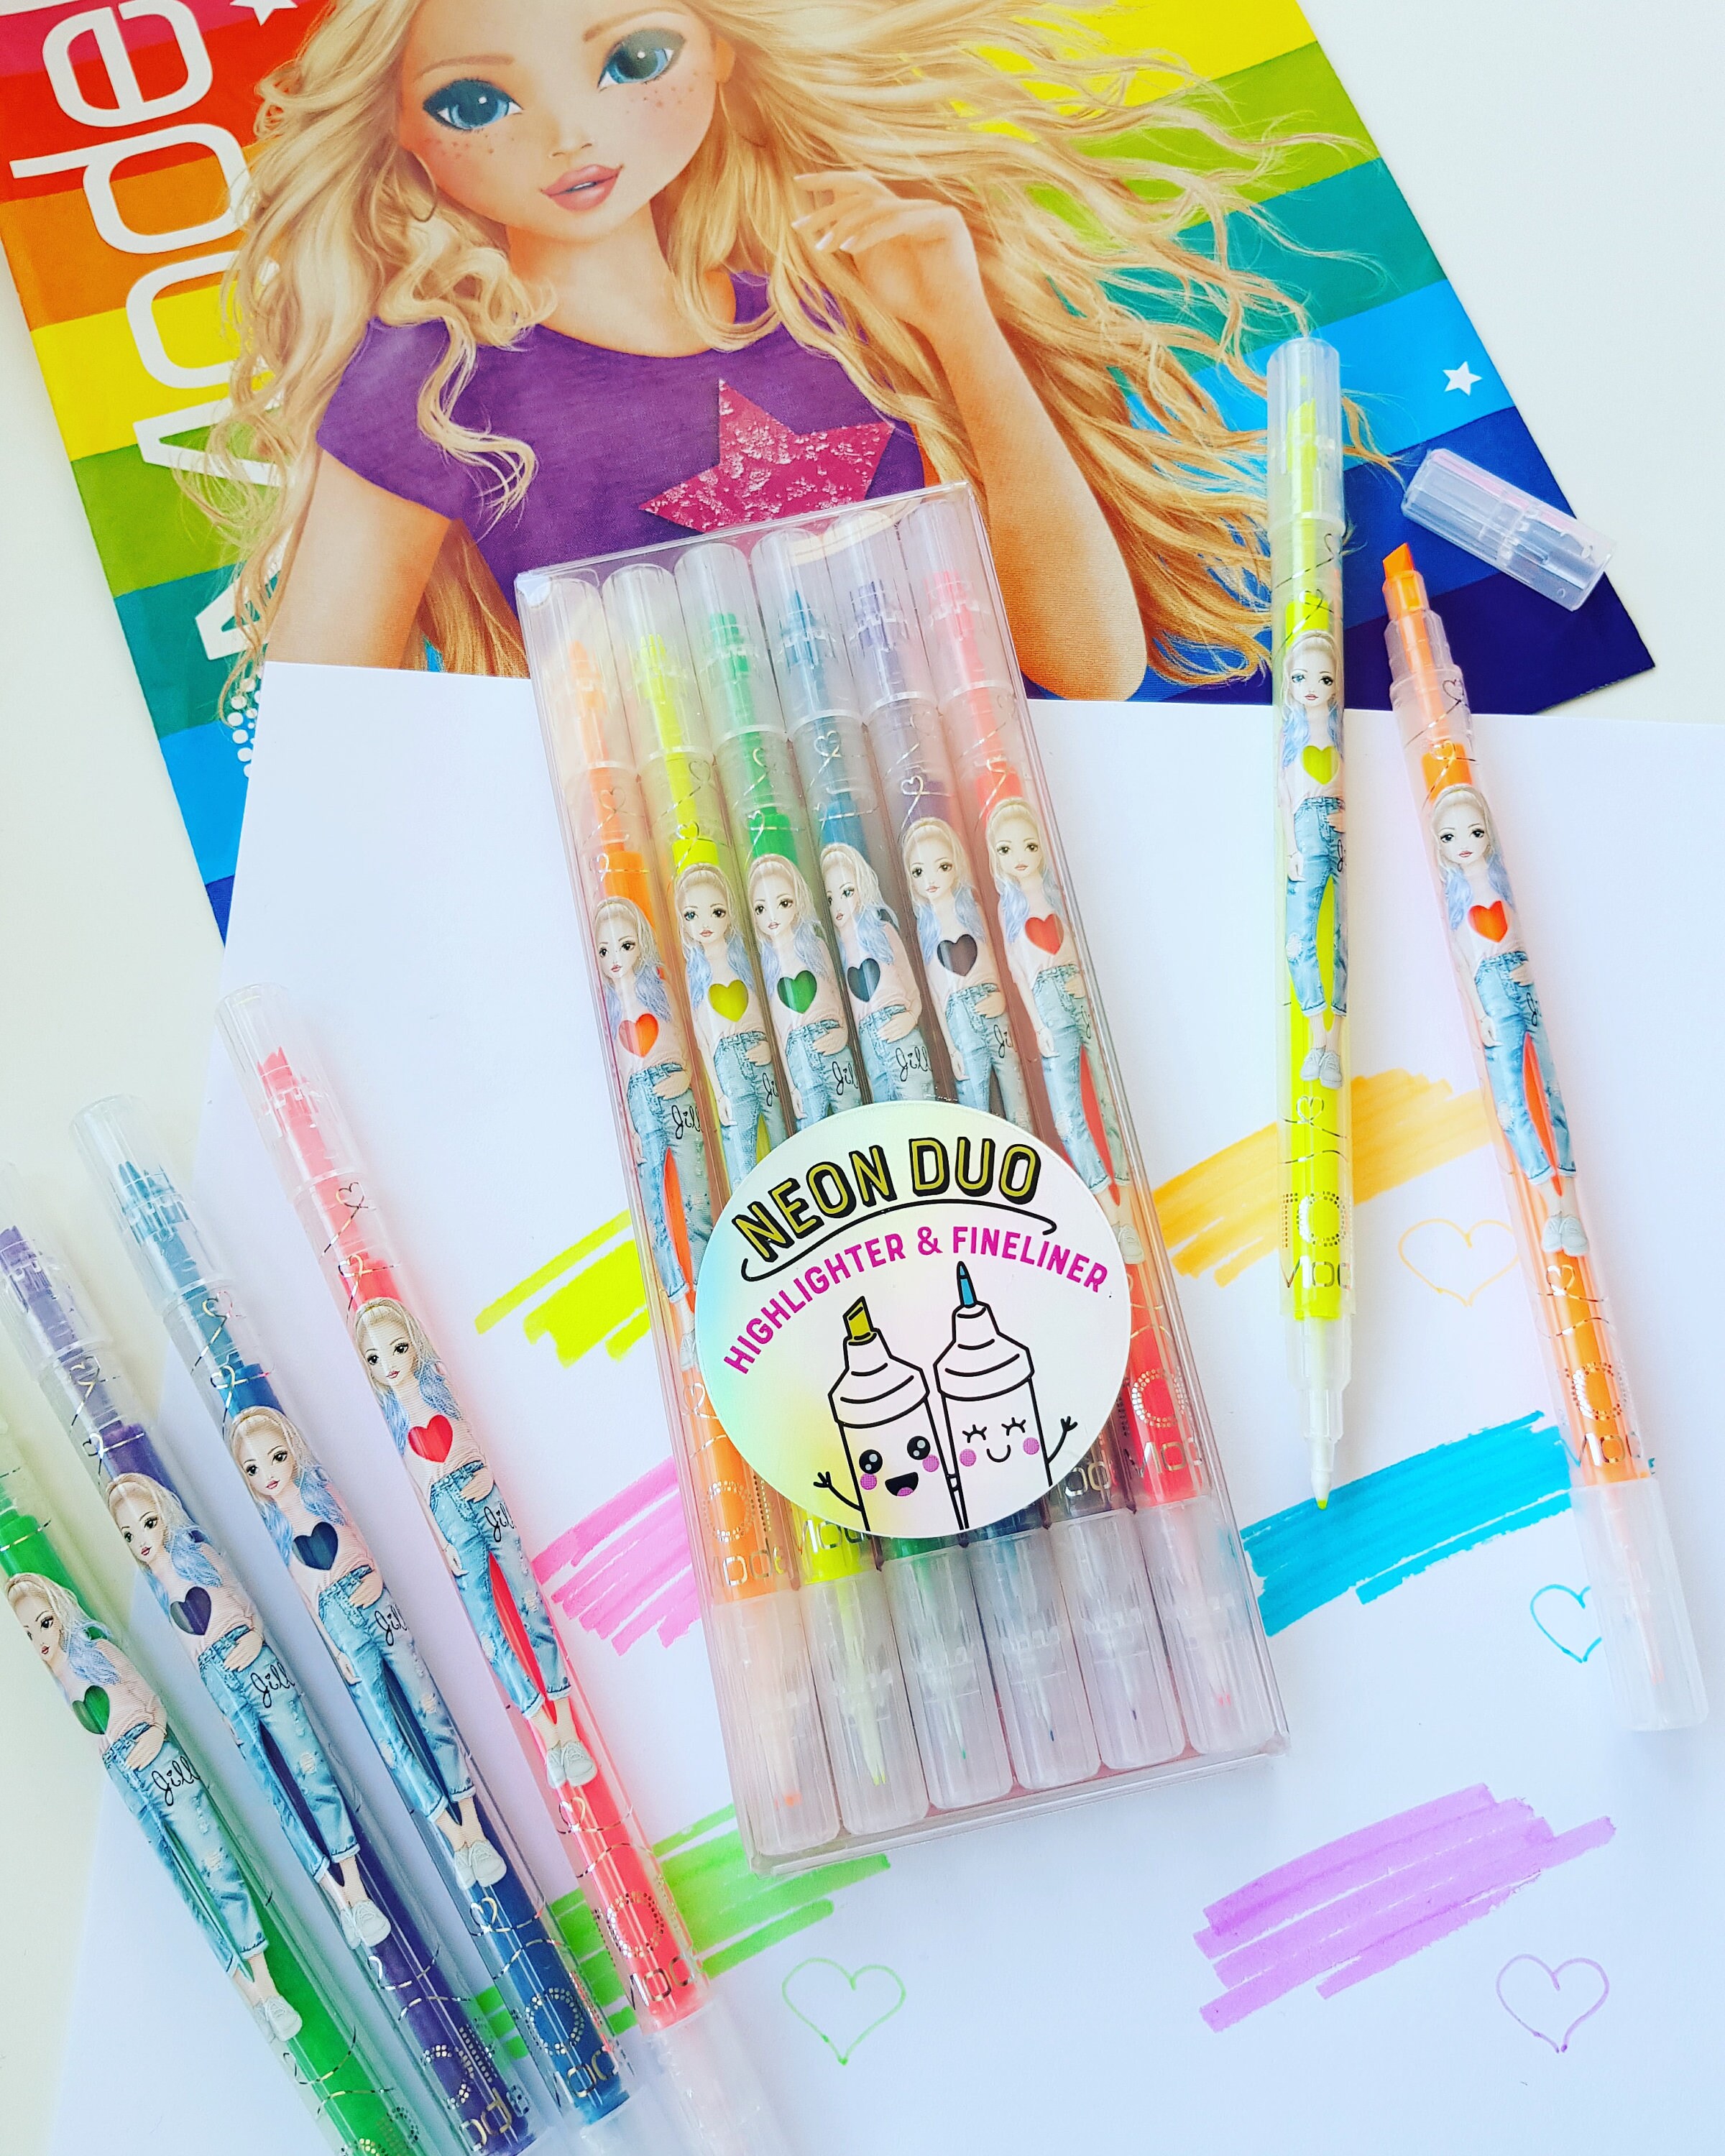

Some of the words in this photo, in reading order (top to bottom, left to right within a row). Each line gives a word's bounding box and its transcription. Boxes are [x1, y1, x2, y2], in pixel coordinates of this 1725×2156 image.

[732, 1145, 897, 1263] NEON
[908, 1136, 1041, 1204] DUO
[723, 1232, 906, 1375] HIGHLIGHTER
[916, 1225, 943, 1256] &
[952, 1226, 1108, 1293] FINELINER
[250, 1661, 295, 1708] Jill
[151, 1755, 201, 1806] Jill
